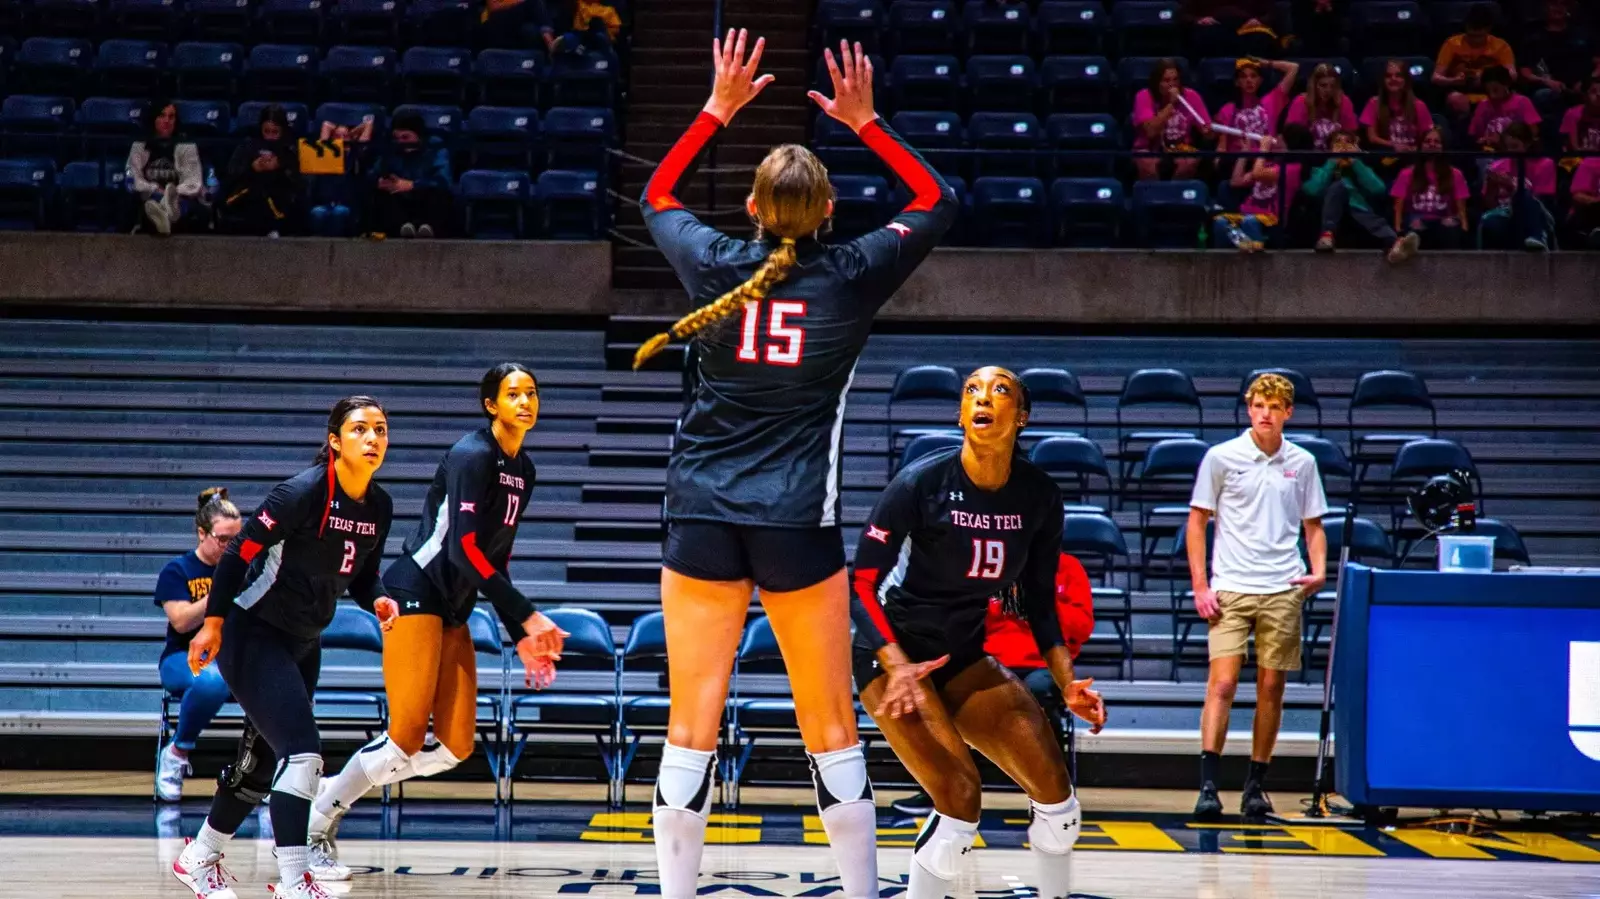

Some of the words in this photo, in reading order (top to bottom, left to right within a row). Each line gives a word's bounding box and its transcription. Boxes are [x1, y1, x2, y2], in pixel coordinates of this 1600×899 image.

[736, 299, 807, 366] 15
[329, 516, 354, 533] TEXAS
[503, 493, 520, 526] 17
[951, 510, 990, 530] TEXAS
[339, 539, 357, 575] 2
[967, 538, 1006, 579] 19
[187, 577, 212, 600] WEST
